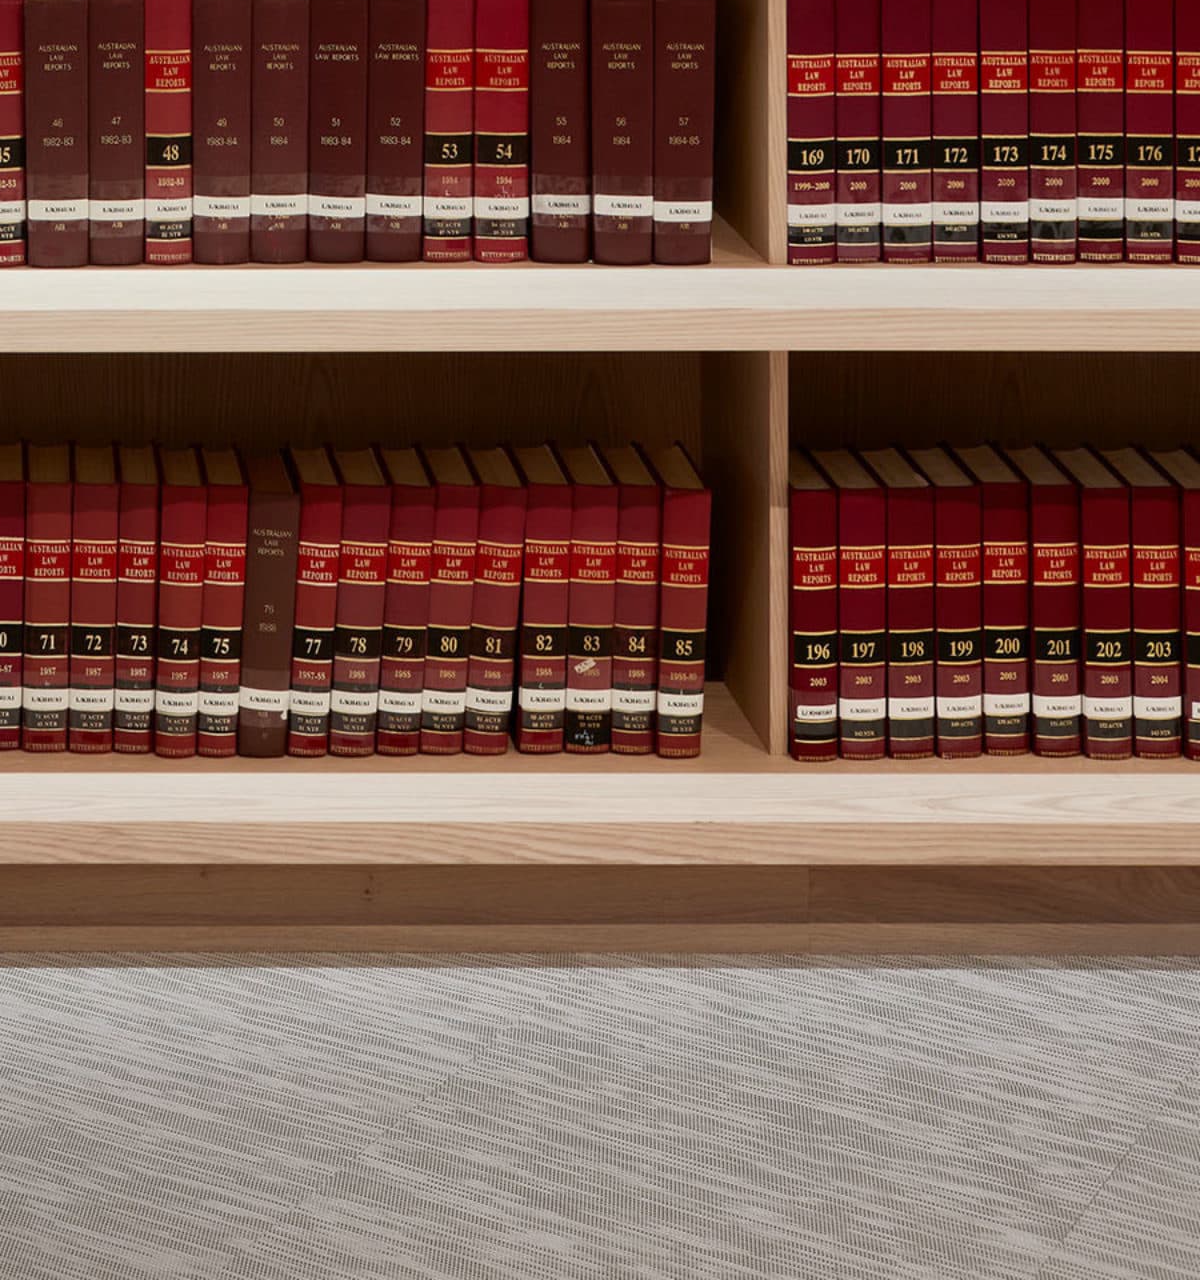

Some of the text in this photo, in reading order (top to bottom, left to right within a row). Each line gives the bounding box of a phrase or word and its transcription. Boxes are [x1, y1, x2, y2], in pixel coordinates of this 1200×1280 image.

[161, 143, 181, 162] 48
[440, 142, 459, 160] 53
[494, 142, 514, 160] 54
[800, 148, 826, 167] 169
[846, 147, 871, 166] 170
[895, 147, 920, 166] 171
[943, 146, 969, 164] 172
[992, 145, 1020, 163] 173
[1040, 144, 1068, 162] 174
[1088, 143, 1115, 162] 175
[1137, 144, 1164, 162] 176
[39, 633, 56, 651] 71
[84, 633, 103, 652] 72
[129, 633, 149, 652] 73
[171, 637, 190, 656] 74
[212, 636, 231, 656] 75
[304, 637, 323, 656] 77
[349, 636, 368, 655] 78
[395, 635, 414, 654] 79
[439, 635, 459, 654] 80
[484, 636, 502, 655] 81
[534, 633, 554, 652] 82
[582, 634, 602, 653] 83
[627, 635, 647, 654] 84
[674, 638, 694, 657] 85
[805, 642, 832, 661] 196
[851, 641, 877, 659] 197
[901, 640, 926, 658] 198
[949, 639, 974, 658] 199
[994, 636, 1022, 656] 200
[1046, 638, 1072, 657] 201
[1095, 640, 1123, 659] 202
[1145, 640, 1173, 659] 203
